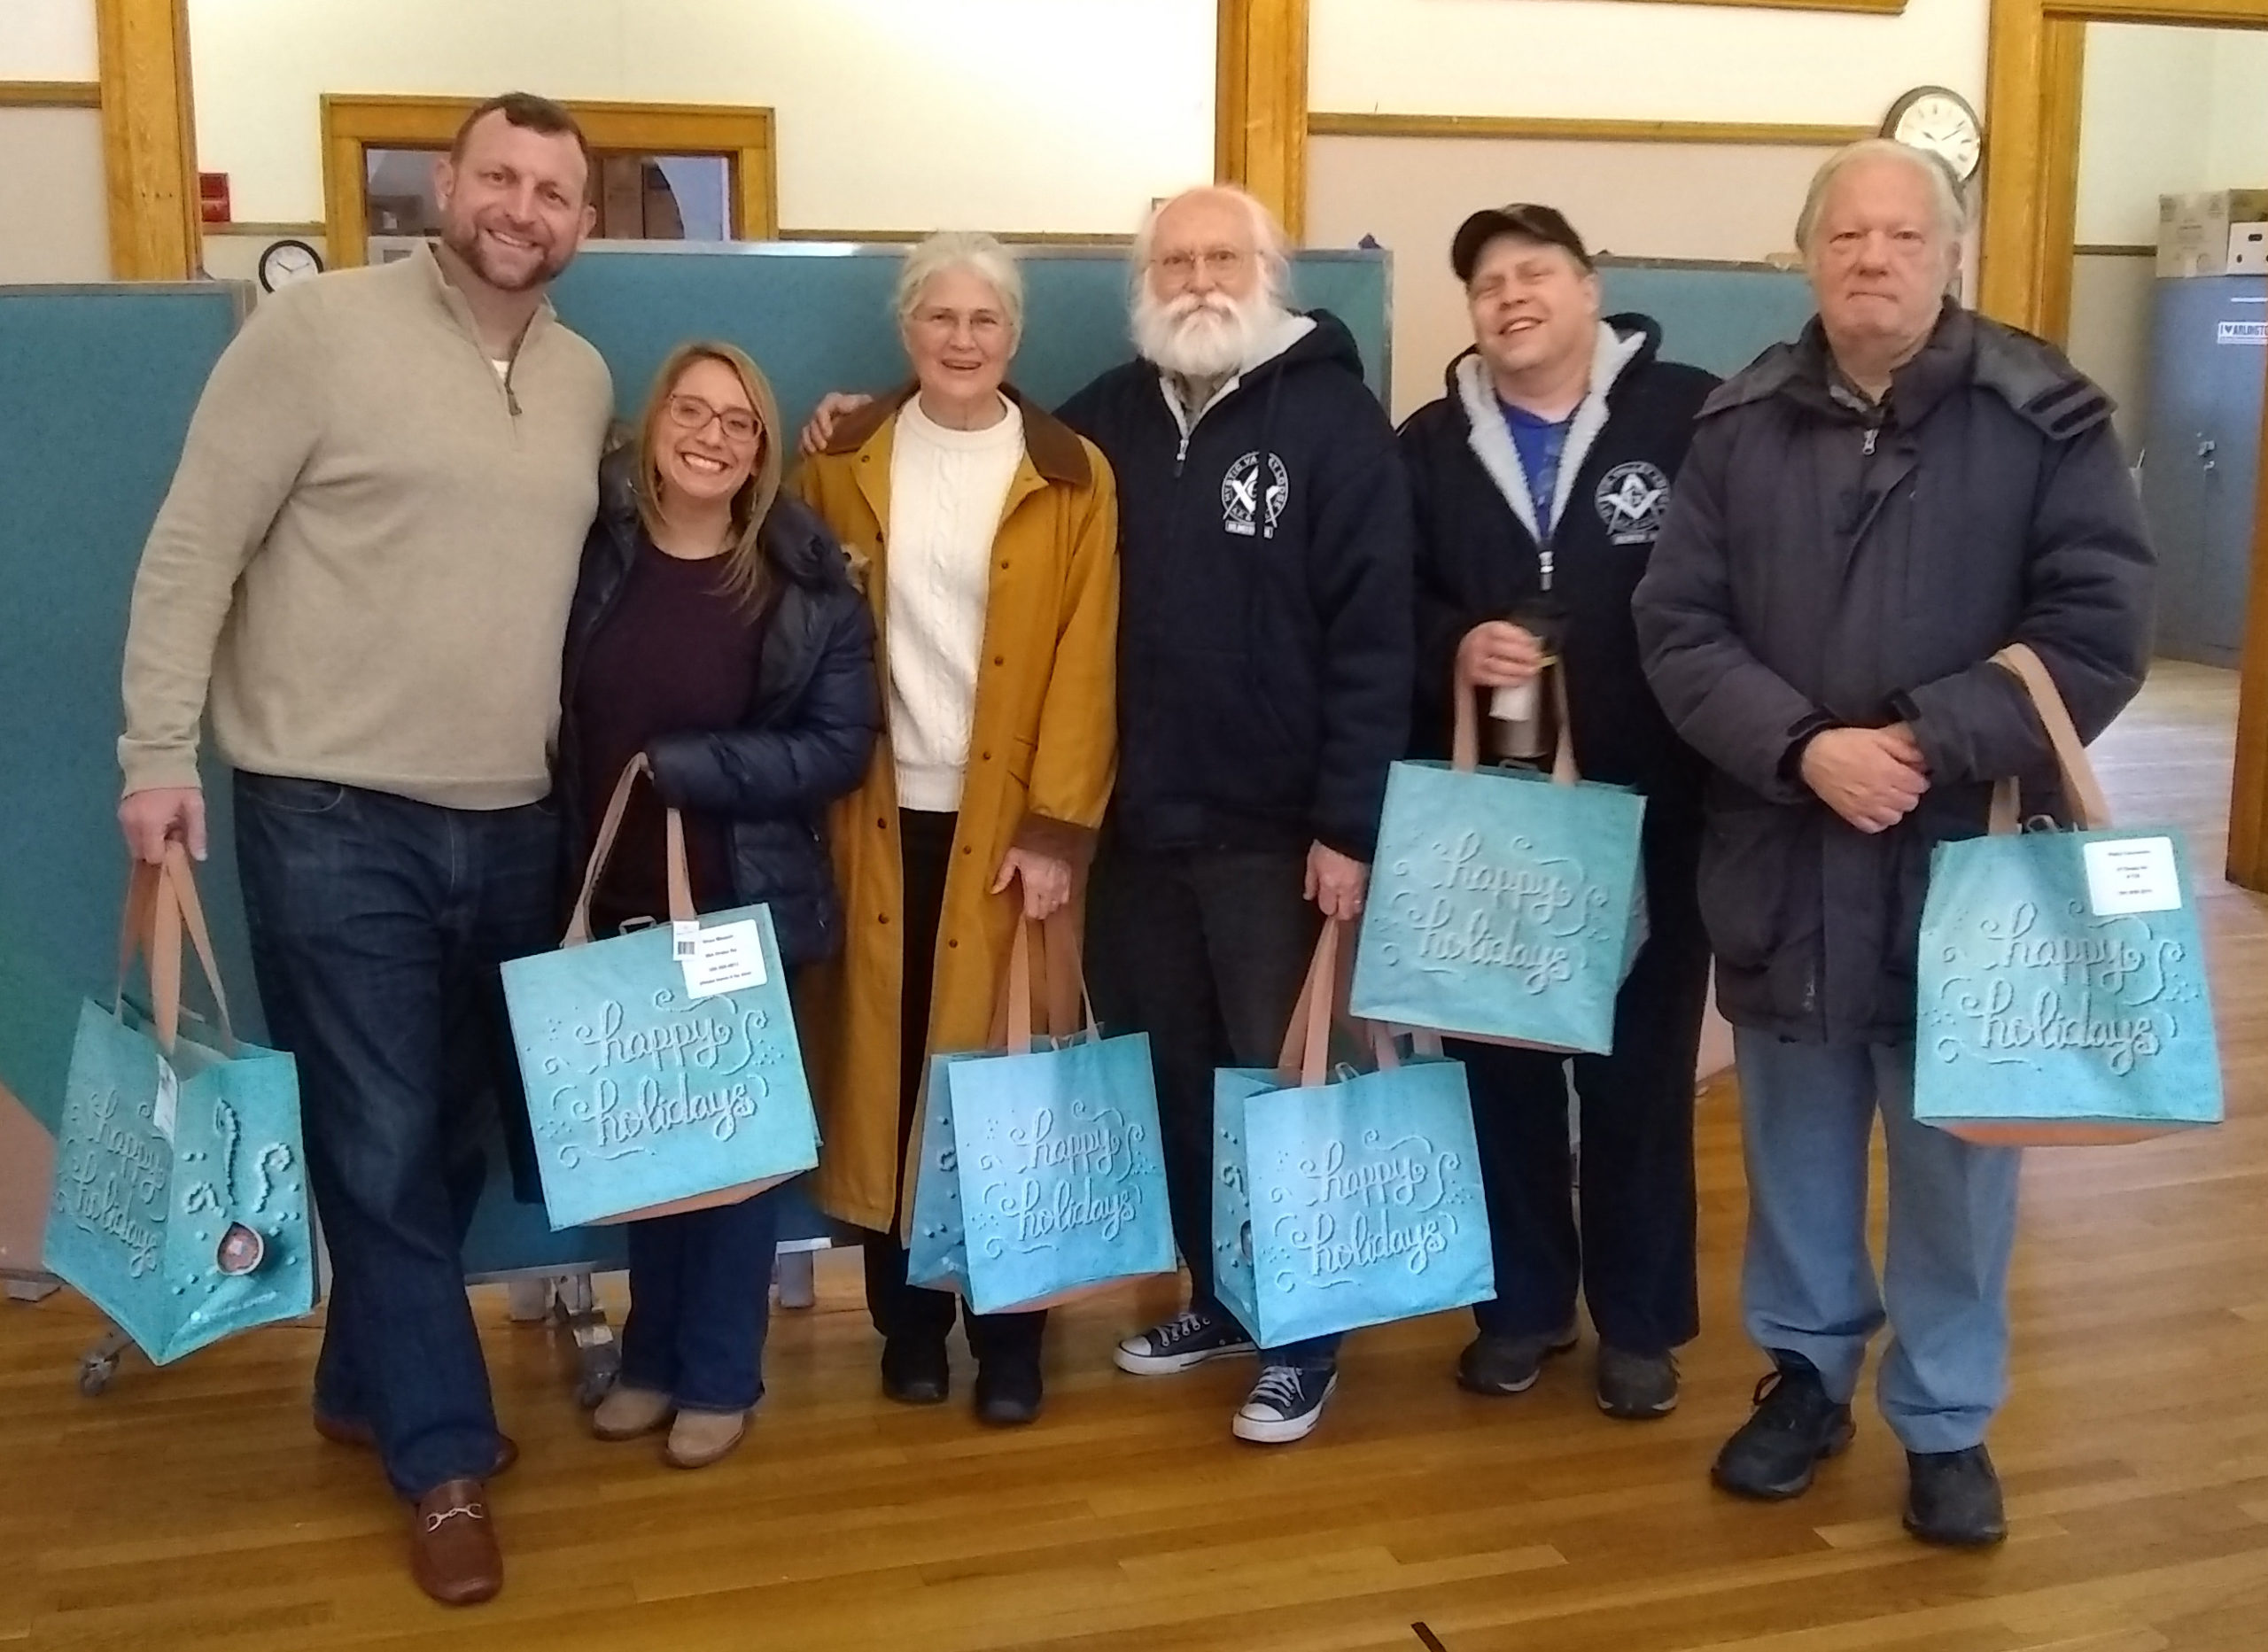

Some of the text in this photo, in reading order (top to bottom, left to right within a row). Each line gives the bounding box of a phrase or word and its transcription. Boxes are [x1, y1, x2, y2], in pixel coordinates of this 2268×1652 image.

[1433, 831, 1575, 926] happy
[1407, 898, 1573, 997] holidays
[1980, 900, 2146, 996] happy
[575, 1000, 734, 1072] happy
[1960, 977, 2162, 1077] holidays
[90, 1090, 166, 1205] happy
[571, 1072, 758, 1148] holidays
[1009, 1107, 1122, 1176] happy
[71, 1151, 159, 1279] holidays
[1000, 1176, 1137, 1242] holidays
[1299, 1139, 1427, 1207] happy
[1290, 1208, 1448, 1276] holidays
